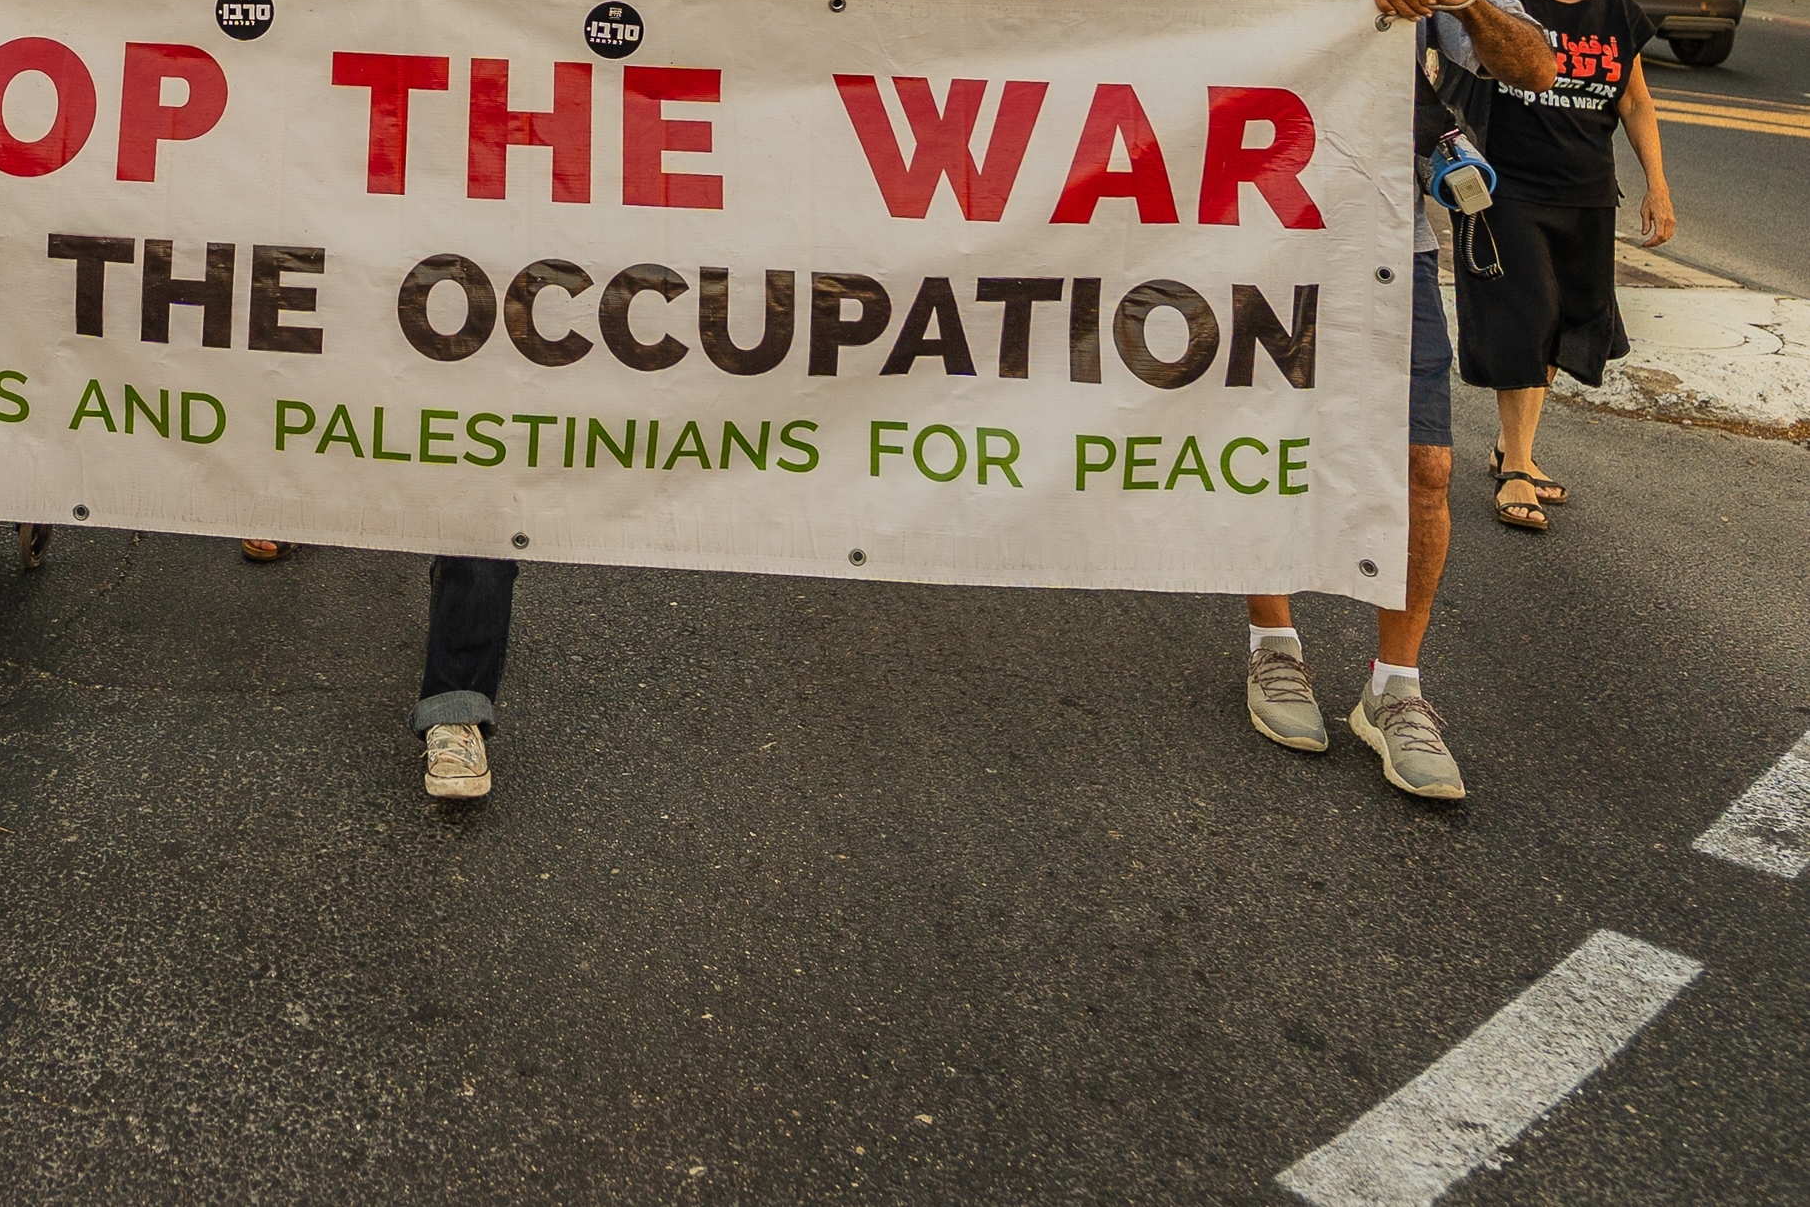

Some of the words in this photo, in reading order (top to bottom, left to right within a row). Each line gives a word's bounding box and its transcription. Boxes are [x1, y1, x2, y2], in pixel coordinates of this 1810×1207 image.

[1561, 33, 1618, 60] أوقفوا
[1498, 80, 1536, 106] Stop
[1539, 89, 1570, 108] the
[1571, 95, 1608, 111] war!
[1586, 82, 1617, 98] את
[332, 52, 723, 210] THE
[832, 74, 1327, 230] WAR
[47, 234, 326, 355] THE
[397, 253, 1319, 391] OCCUPATION
[69, 379, 228, 445] AND
[275, 400, 821, 475] PALESTINIANS
[870, 420, 1024, 489] FOR
[1076, 434, 1310, 496] PEACE
